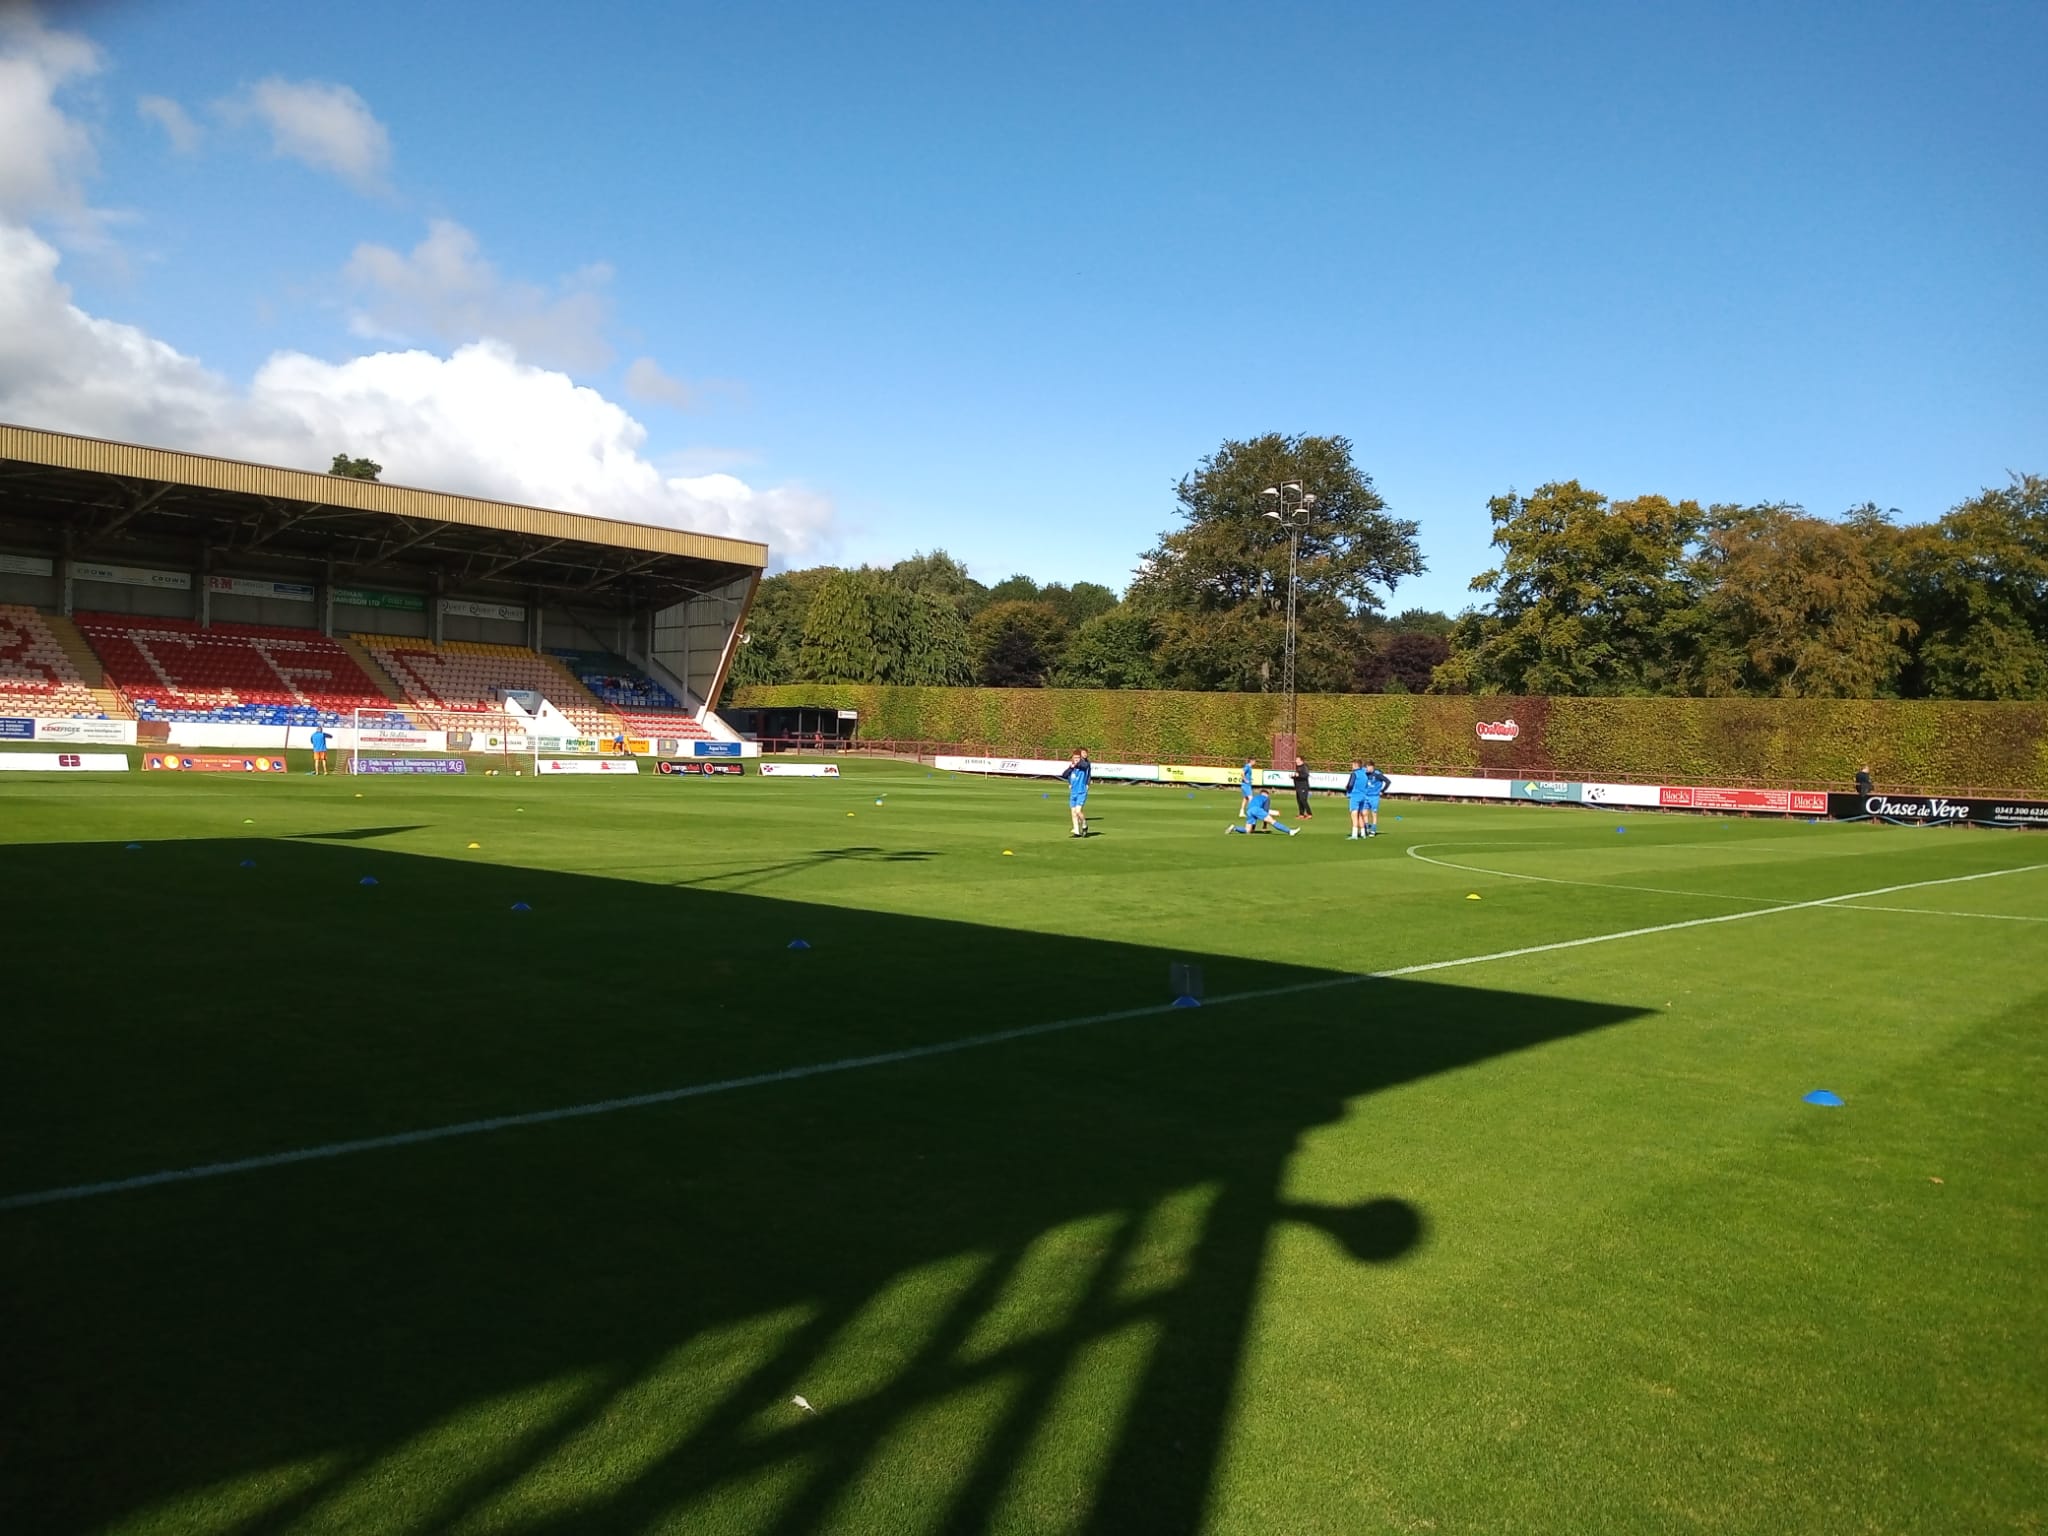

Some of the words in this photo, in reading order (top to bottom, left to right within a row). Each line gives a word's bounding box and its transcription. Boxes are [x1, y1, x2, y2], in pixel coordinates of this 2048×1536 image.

[1865, 796, 1917, 815] Chase
[1917, 804, 1930, 816] de
[1929, 798, 1970, 818] Vere
[1995, 806, 2014, 815] 0345
[2014, 807, 2029, 815] 300
